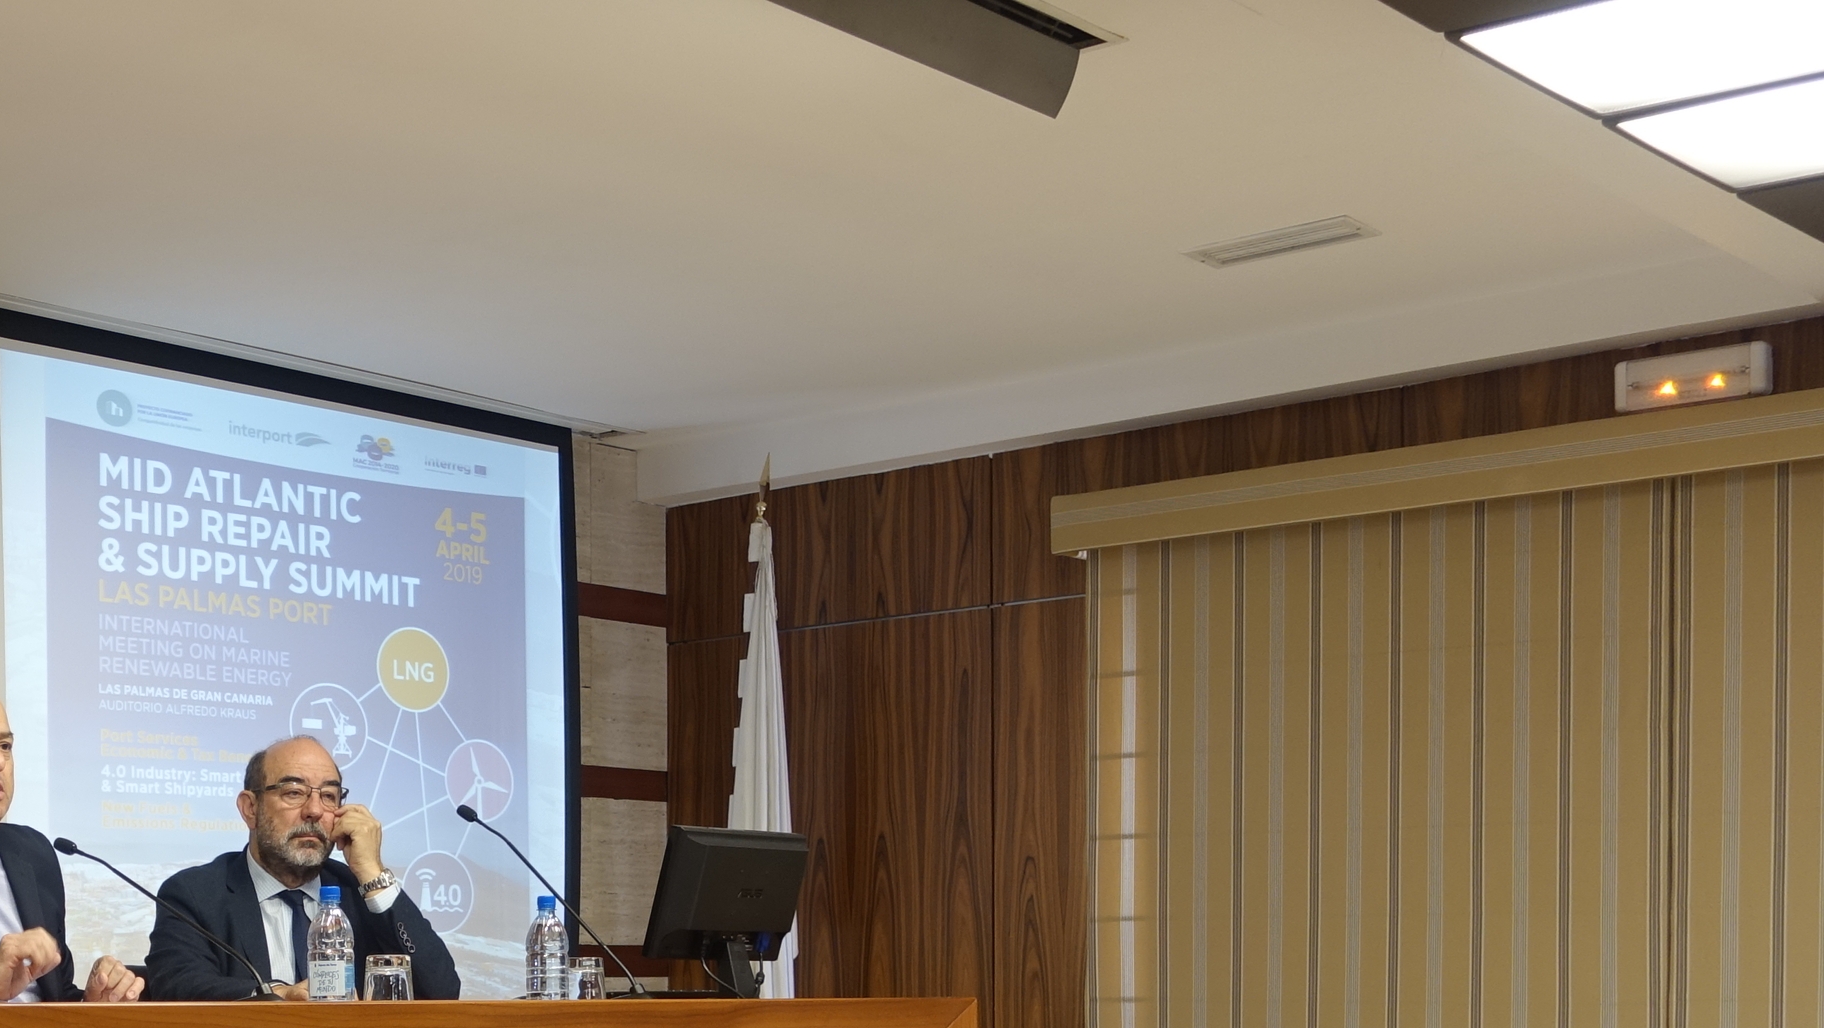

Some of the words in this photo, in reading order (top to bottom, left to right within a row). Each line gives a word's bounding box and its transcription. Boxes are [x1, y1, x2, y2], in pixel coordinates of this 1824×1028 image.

[229, 421, 292, 444] interport
[99, 452, 172, 494] MID
[184, 467, 361, 523] ATLANTIC
[98, 495, 189, 537] SHIP
[201, 509, 331, 558] REPAIR
[434, 507, 488, 543] 4-5
[436, 539, 490, 564] APRIL
[98, 537, 126, 573] &
[136, 542, 278, 590] SUPPLY
[288, 562, 420, 607] SUMMIT
[443, 562, 482, 585] 2019
[98, 578, 149, 606] LAS
[159, 585, 261, 617] PALMAS
[269, 598, 333, 626] PORT
[99, 613, 249, 643] INTERNATIONAL
[99, 635, 183, 658] MEETING
[189, 643, 216, 660] ON
[222, 646, 291, 667] MARINE
[99, 656, 217, 681] RENEWABLE
[223, 666, 292, 687] ENERGY
[393, 659, 435, 683] LNG
[98, 683, 121, 695] LAS
[124, 684, 170, 698] PALMAS
[173, 689, 188, 699] DE
[190, 689, 222, 702] GRAN
[224, 692, 273, 706] CANARIA
[99, 699, 162, 714] AUDITORIO
[166, 703, 217, 717] ALFREDO
[220, 707, 256, 720] KRAUS
[100, 728, 133, 743] Port
[137, 731, 199, 746] Services
[101, 743, 173, 759] Economic
[192, 747, 215, 762] Tax
[101, 764, 126, 778] 4.0
[131, 765, 196, 783] Industry:
[200, 769, 242, 784] Smart
[101, 780, 111, 793] &
[116, 780, 160, 795] Smart
[164, 782, 234, 798] Shipyards
[102, 801, 134, 813] New
[139, 802, 177, 814] Fuels
[102, 815, 175, 828] Emissions
[433, 884, 461, 905] 4.0
